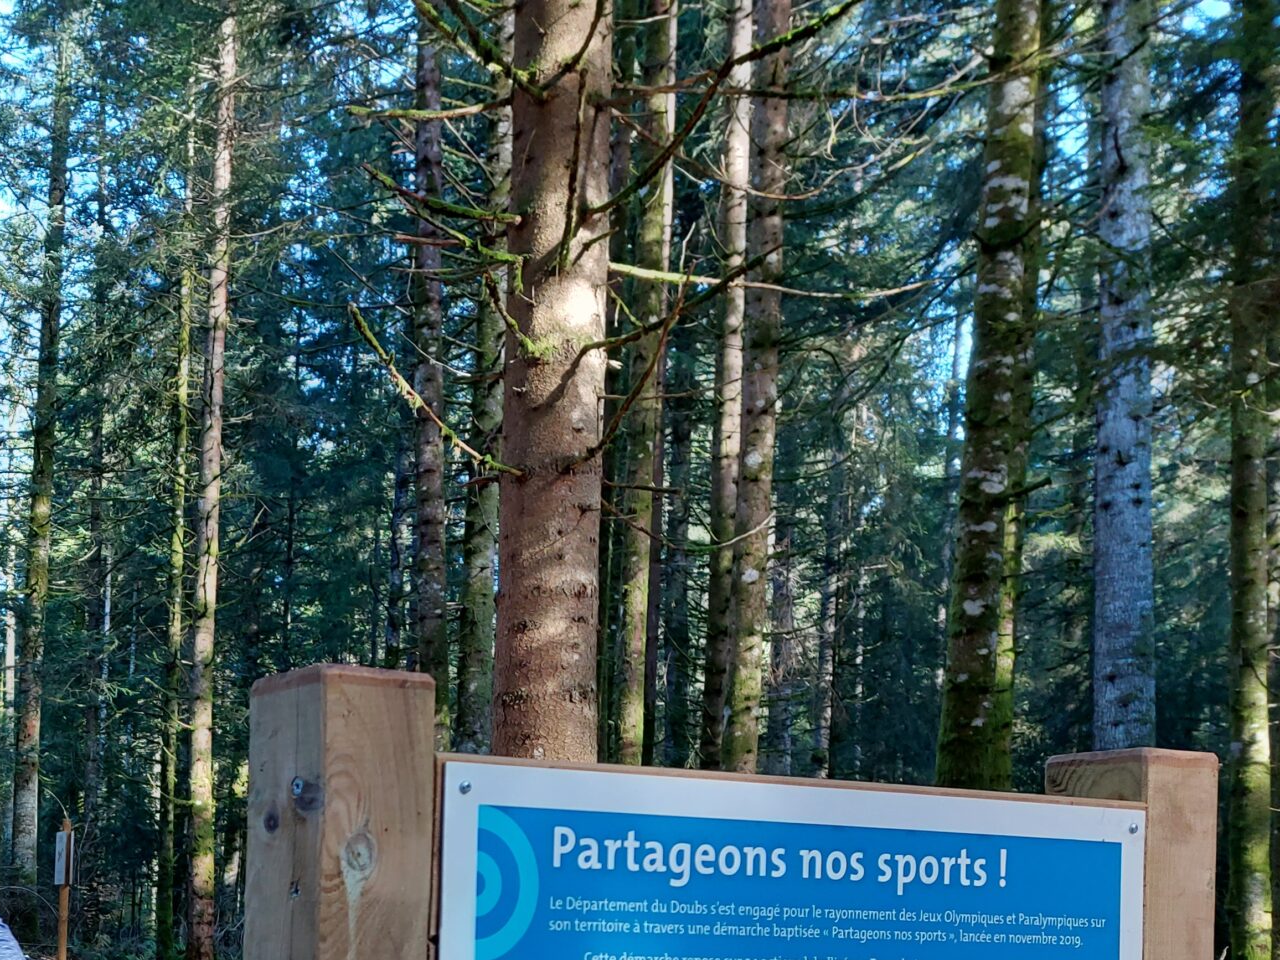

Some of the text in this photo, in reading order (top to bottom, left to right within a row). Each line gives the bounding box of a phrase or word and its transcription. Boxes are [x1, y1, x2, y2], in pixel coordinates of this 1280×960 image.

[552, 825, 1007, 896] Partageons nos sports !
[549, 895, 1106, 931] Le Département du Doubs s'est engagé pour le rayonnement des Jeux Olympiques et Paralympiques sur
[548, 919, 572, 931] son
[573, 917, 631, 933] territoire
[631, 919, 641, 933] à
[642, 920, 685, 935] travers
[687, 924, 711, 935] une
[712, 921, 771, 937] démarche
[771, 922, 821, 941] baptisée
[831, 925, 892, 944] Partageons
[893, 930, 913, 941] nos
[913, 929, 947, 945] sports
[958, 928, 992, 943] lancée
[992, 932, 1007, 943] en
[1007, 930, 1058, 945] novembre
[1058, 934, 1084, 949] 2019.
